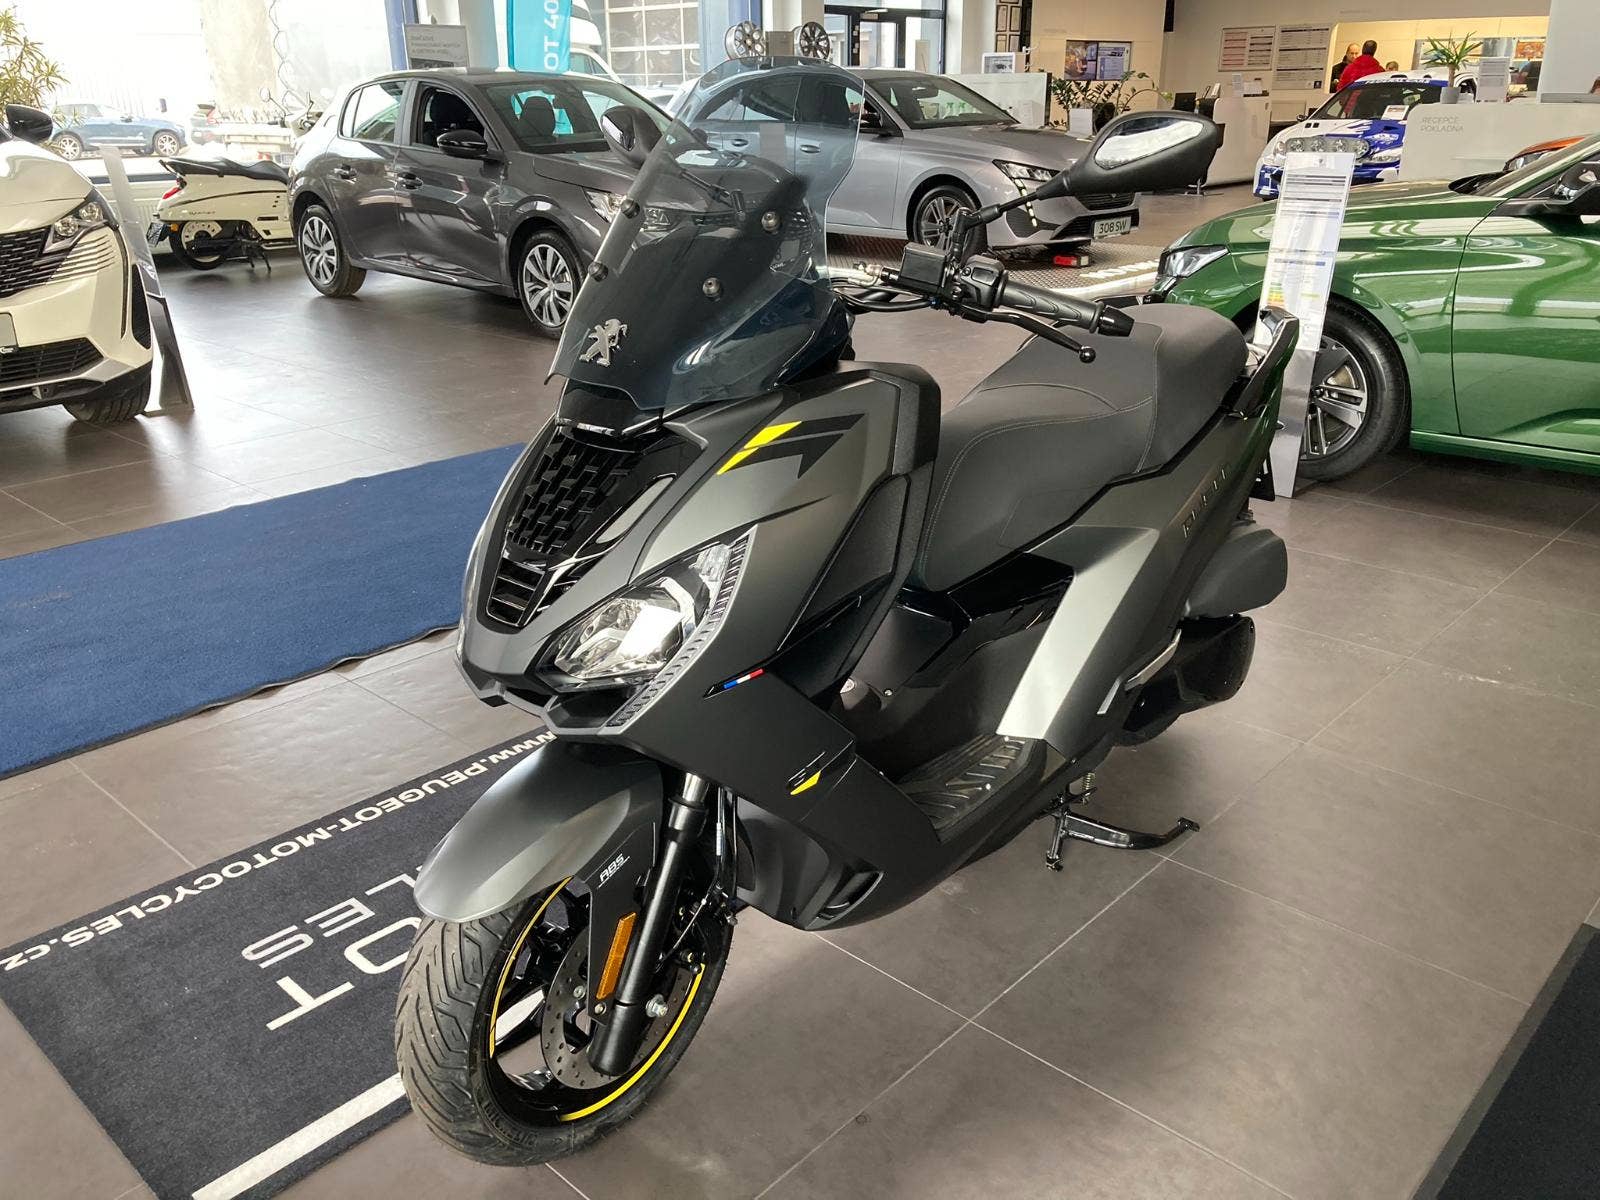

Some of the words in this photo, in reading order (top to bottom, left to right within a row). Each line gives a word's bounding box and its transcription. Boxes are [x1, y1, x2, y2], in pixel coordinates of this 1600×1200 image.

[1098, 222, 1114, 234] 308
[1115, 219, 1128, 232] SW
[599, 853, 625, 883] ABS
[241, 865, 423, 969] LES
